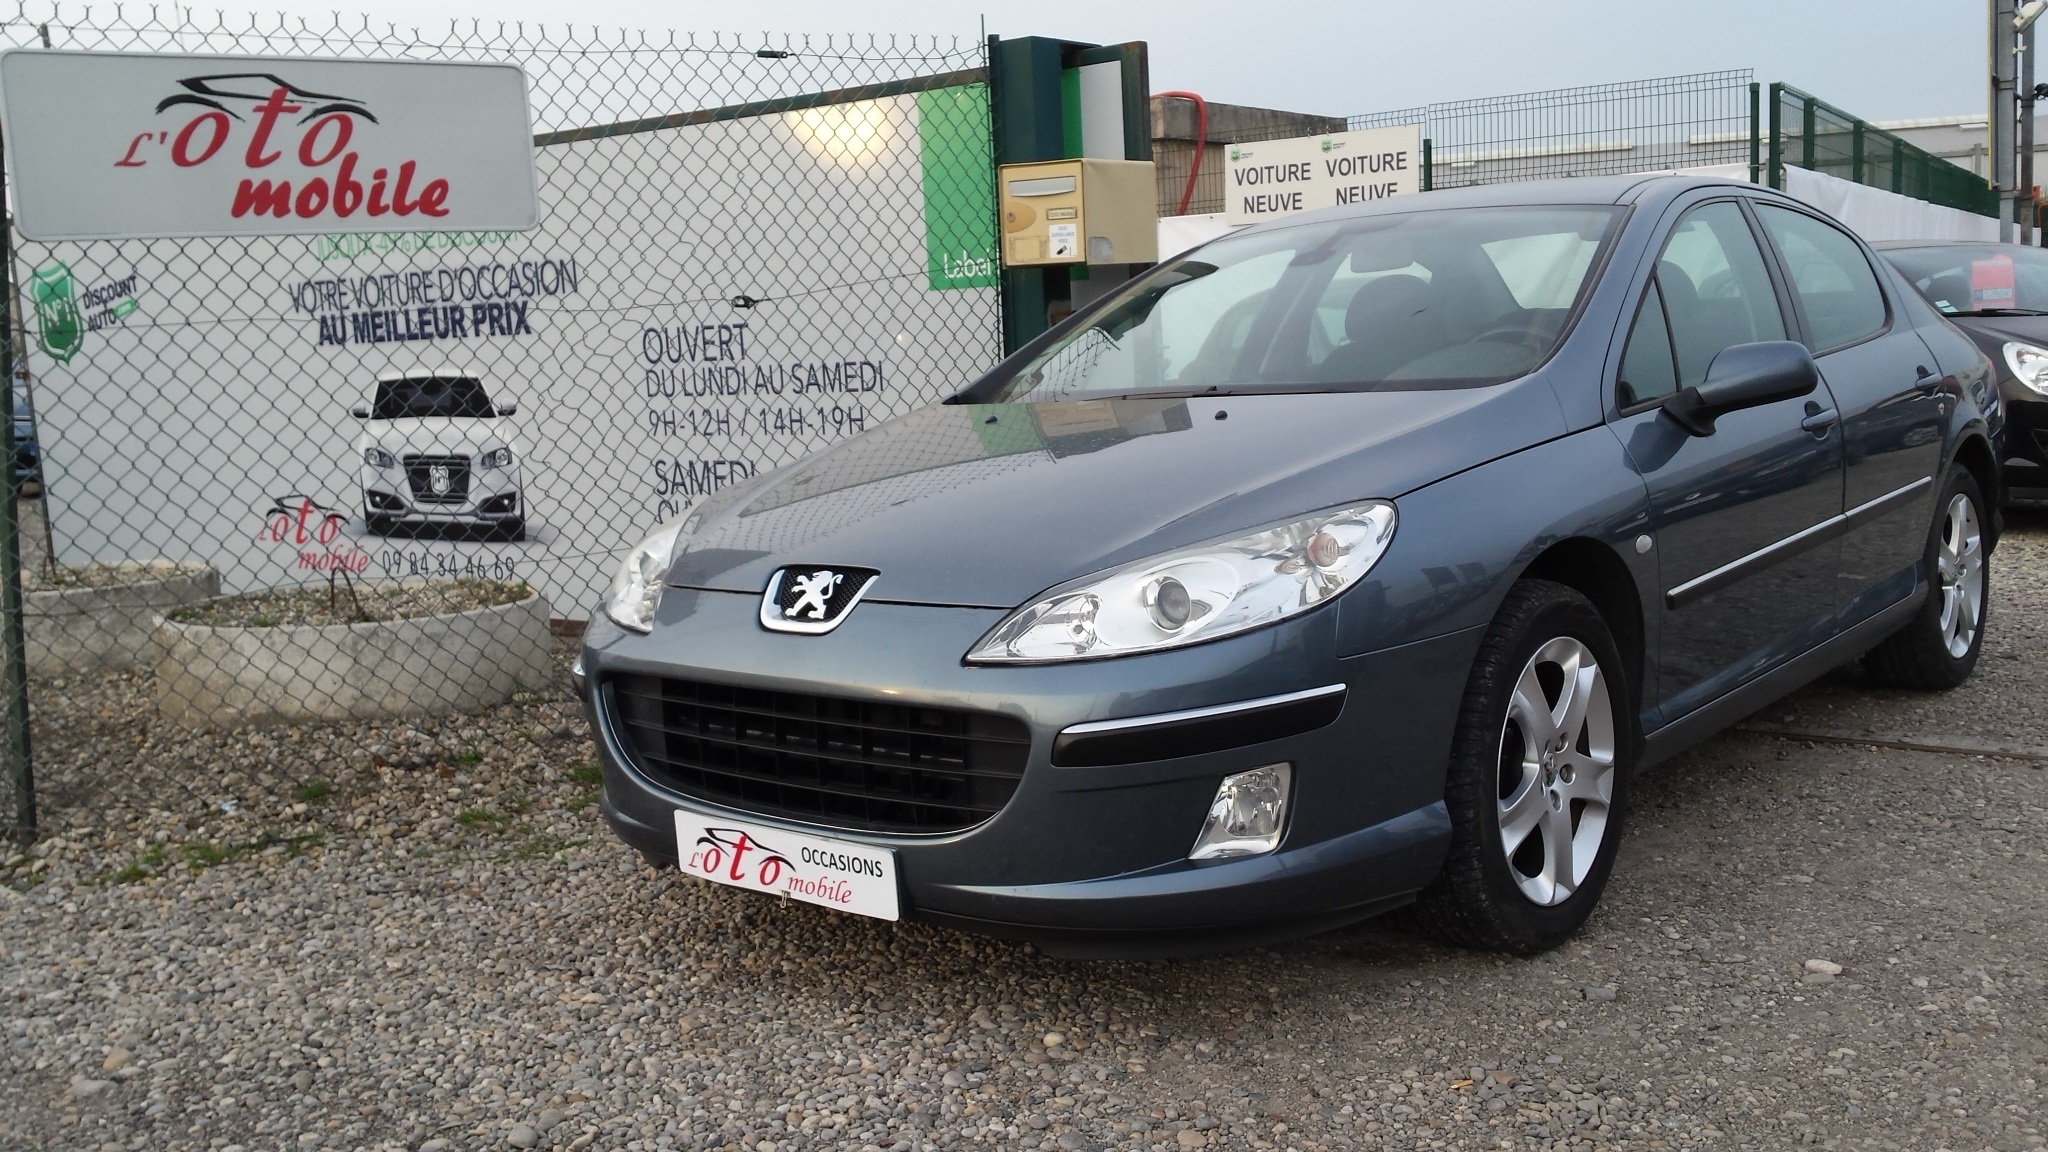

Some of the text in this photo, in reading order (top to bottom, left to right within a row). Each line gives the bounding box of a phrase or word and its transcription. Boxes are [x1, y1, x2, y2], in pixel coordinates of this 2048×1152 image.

[1234, 162, 1311, 186] VOITURE
[1325, 151, 1407, 178] VOITURE
[231, 152, 450, 218] mobile
[1336, 182, 1398, 206] NEUVE
[1243, 192, 1303, 214] NEUVE
[83, 275, 136, 309] DISCOUNT
[289, 258, 579, 313] VOTRE VOITURE D'OCCASION
[88, 308, 116, 331] AUTO
[319, 300, 532, 346] AU MEILLEUR PRIX
[642, 322, 749, 364] OUVERT
[646, 360, 884, 397] DU LUNDI AU SAMEDI
[649, 408, 731, 437] 9H-12H
[759, 405, 865, 435] 14H-19H
[298, 544, 368, 573] mobile
[382, 550, 515, 581] 09 84 34 46 69
[801, 846, 883, 878] OCCASIONS
[787, 875, 852, 904] mobile
